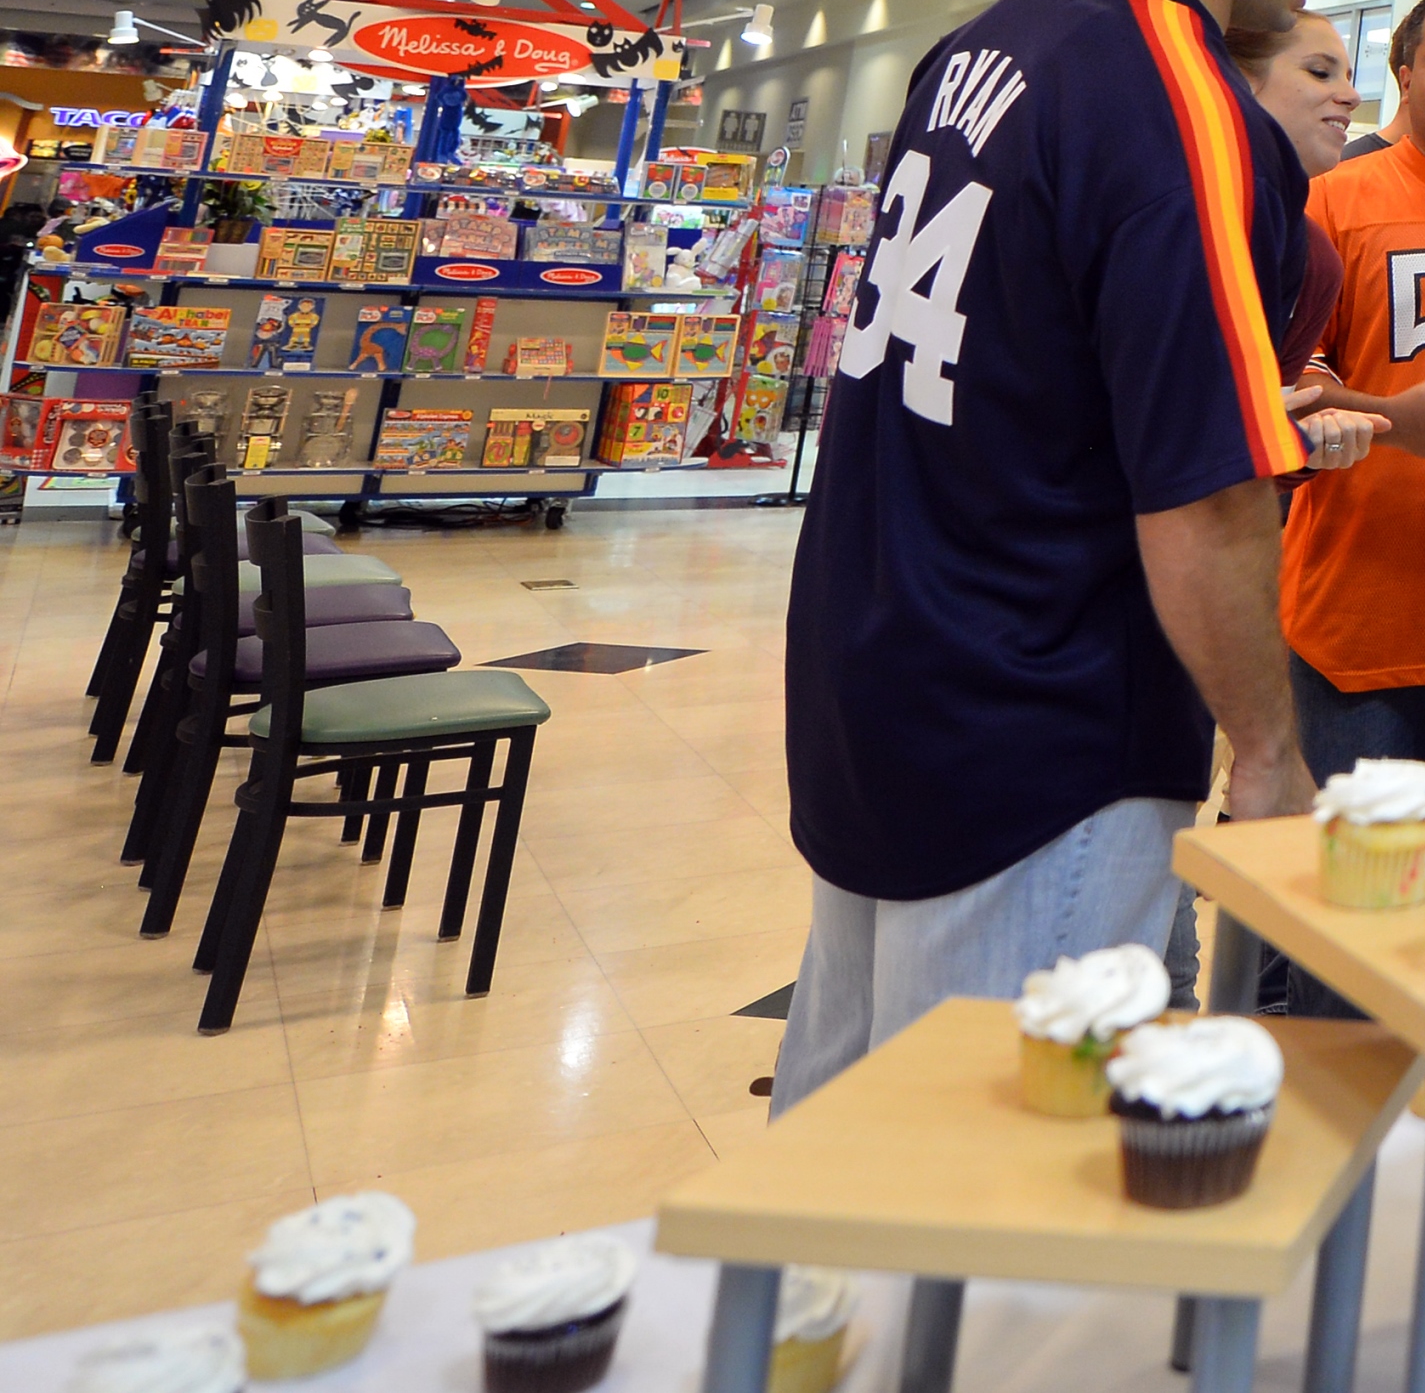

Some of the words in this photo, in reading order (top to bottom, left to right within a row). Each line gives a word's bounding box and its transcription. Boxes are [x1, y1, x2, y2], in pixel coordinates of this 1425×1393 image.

[378, 25, 485, 57] Melissa
[493, 40, 507, 56] &
[514, 39, 572, 73] Doug
[927, 49, 1027, 157] RYAN
[839, 149, 993, 426] 34
